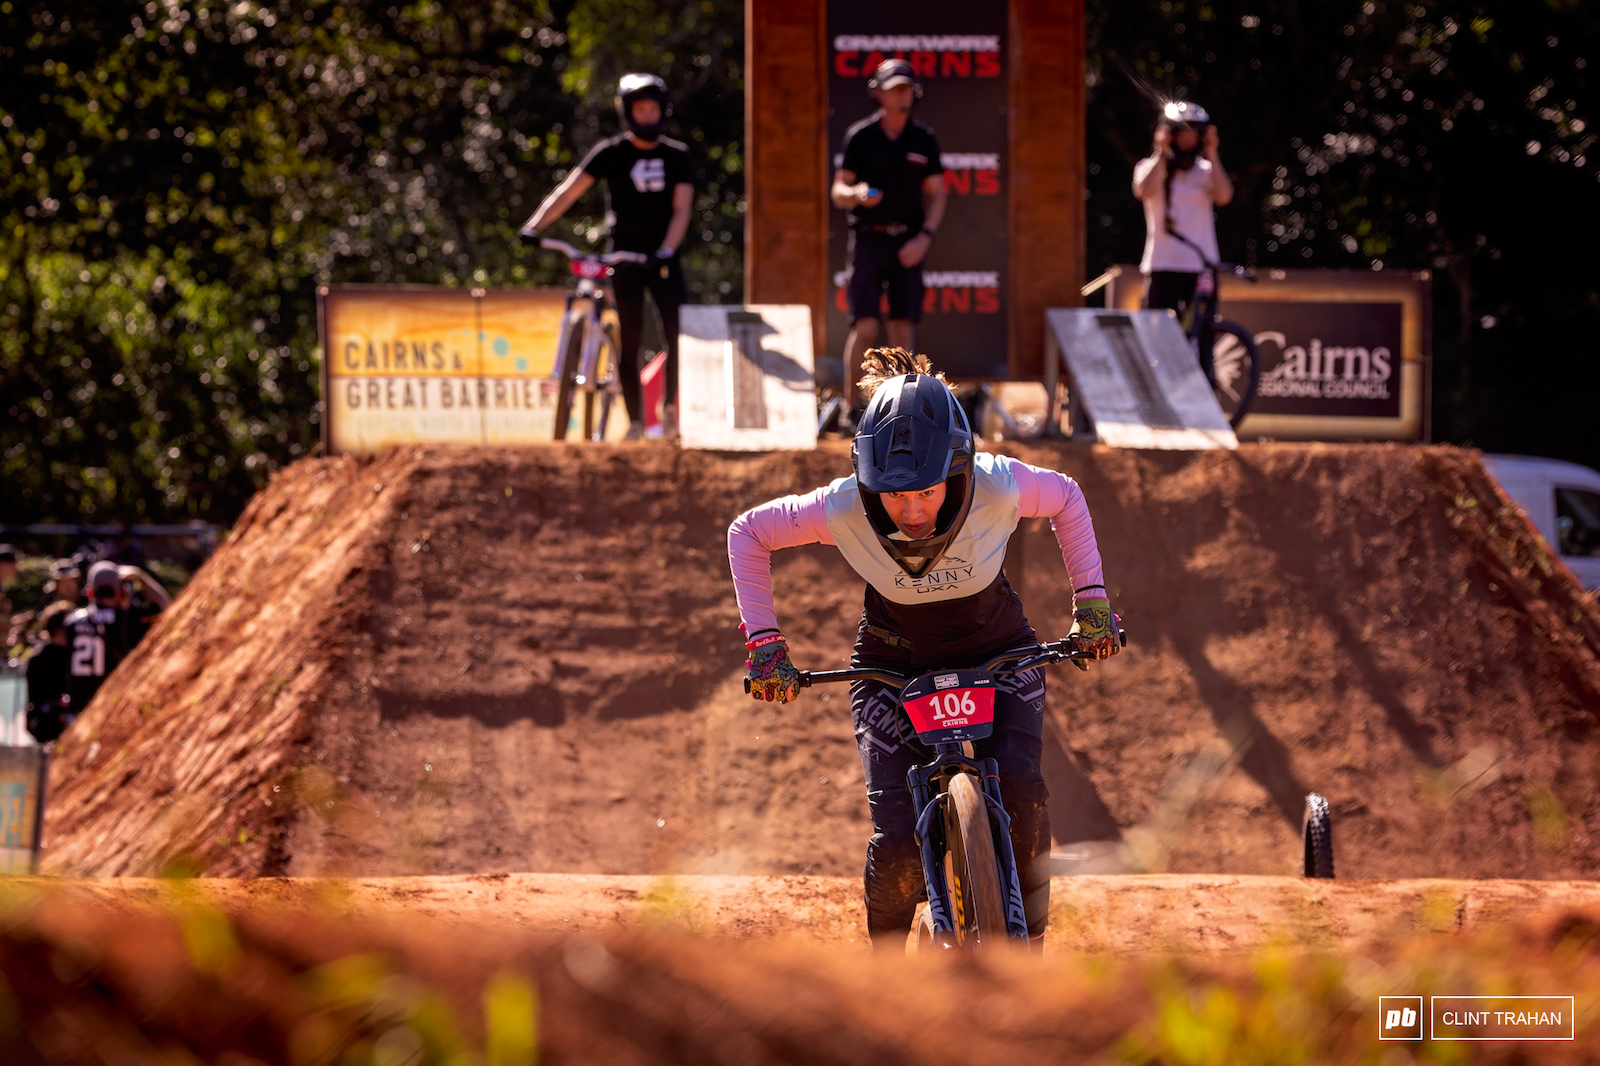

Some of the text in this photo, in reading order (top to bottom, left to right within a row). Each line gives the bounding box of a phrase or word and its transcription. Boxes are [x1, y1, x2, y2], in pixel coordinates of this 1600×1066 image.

[344, 340, 446, 370] CAIRNS
[346, 381, 429, 410] GREAT
[71, 635, 105, 677] 21
[929, 691, 976, 720] 106
